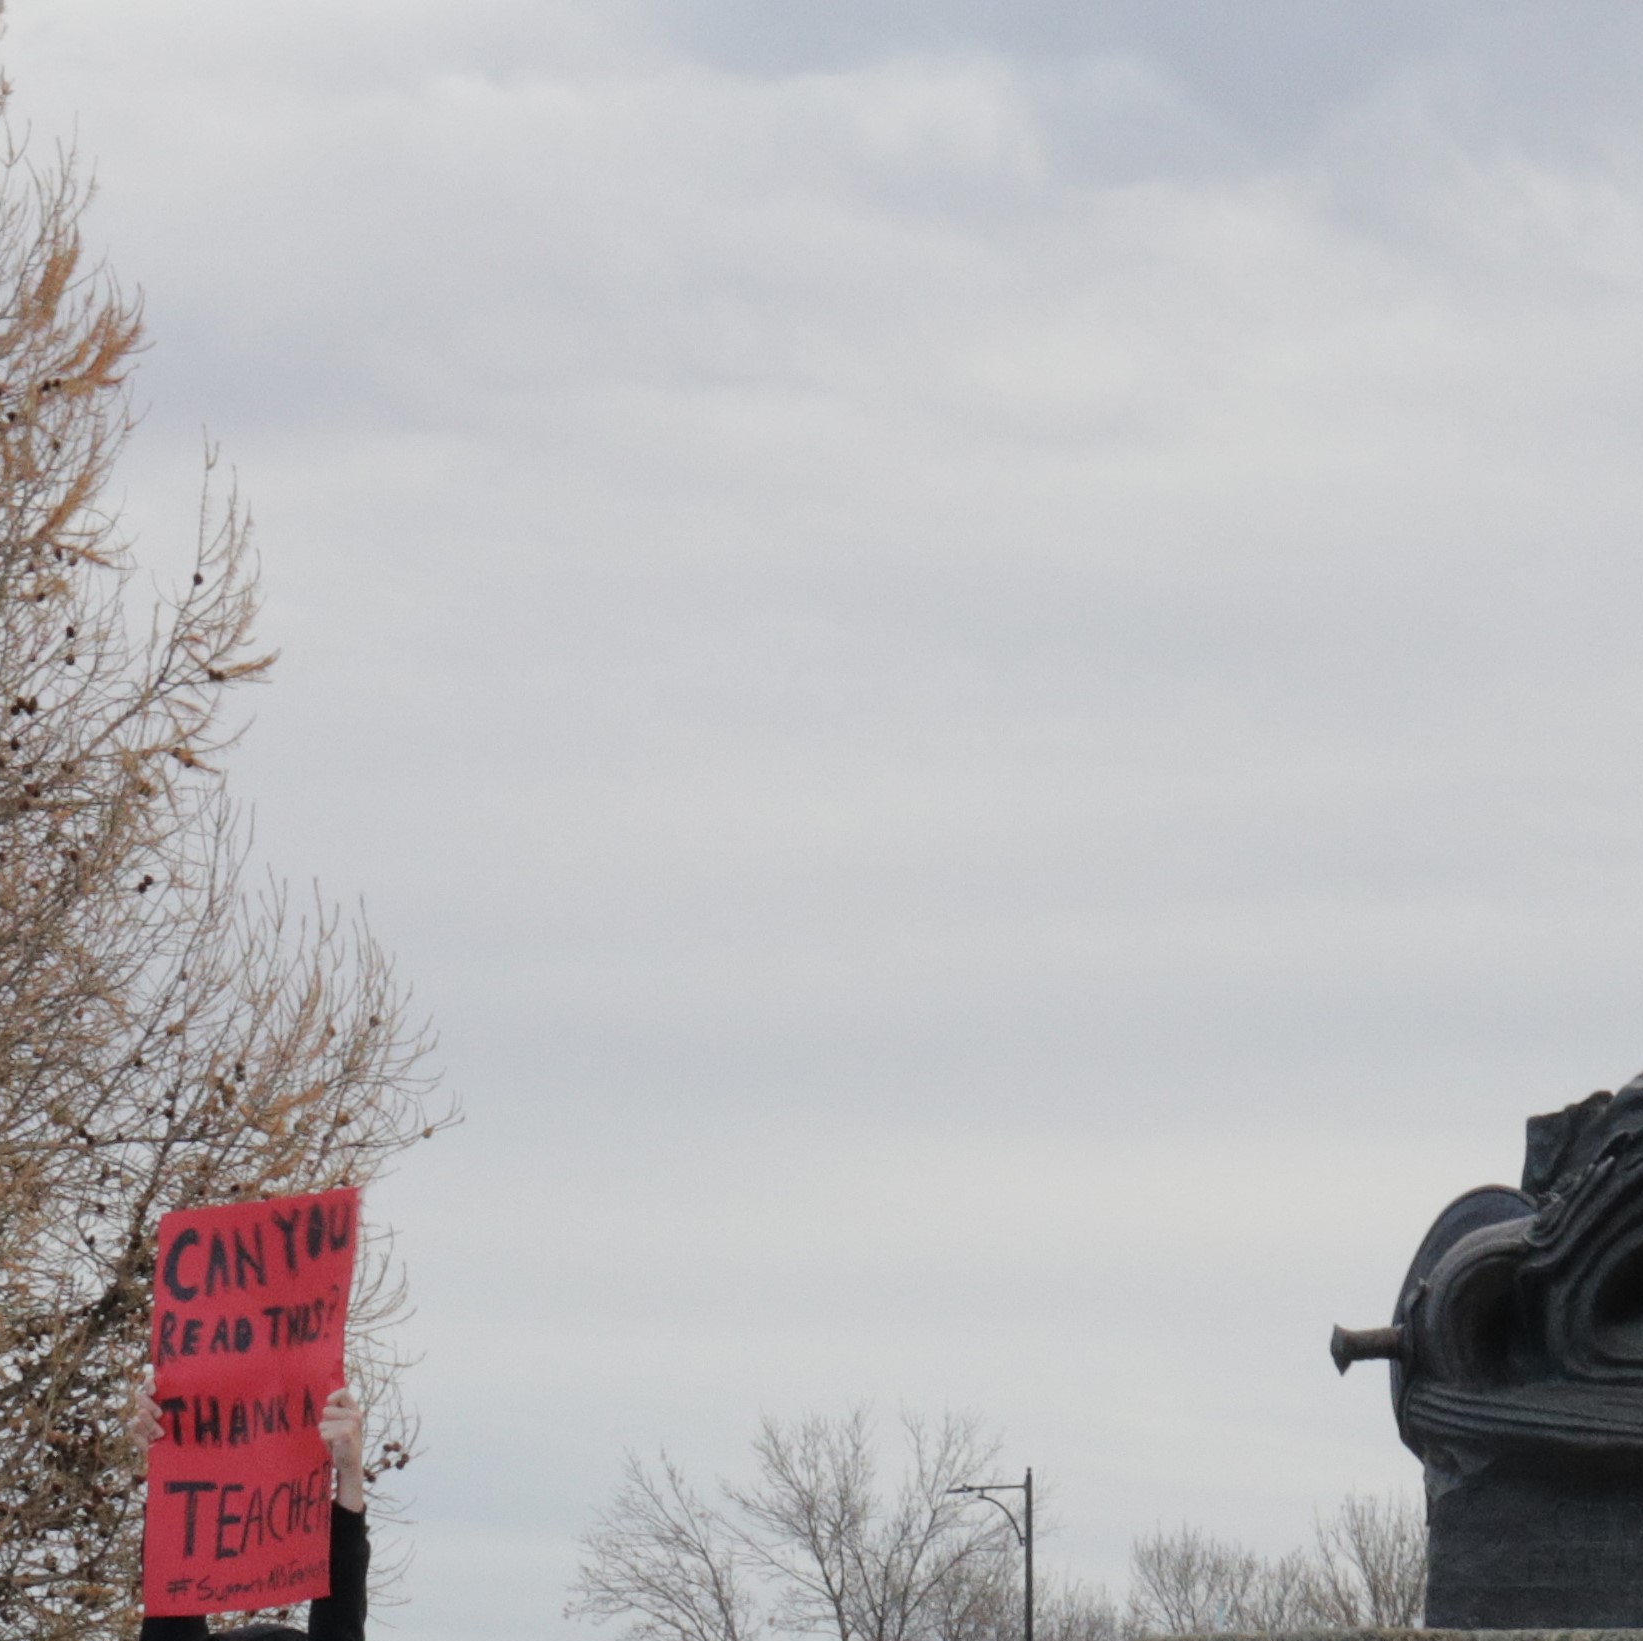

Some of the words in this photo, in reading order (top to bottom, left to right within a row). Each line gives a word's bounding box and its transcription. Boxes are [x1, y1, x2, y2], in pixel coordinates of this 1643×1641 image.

[164, 1228, 267, 1302] CAN
[271, 1201, 354, 1277] YOU
[157, 1311, 253, 1366] READ
[160, 1393, 290, 1447] THANK
[301, 1386, 318, 1427] A
